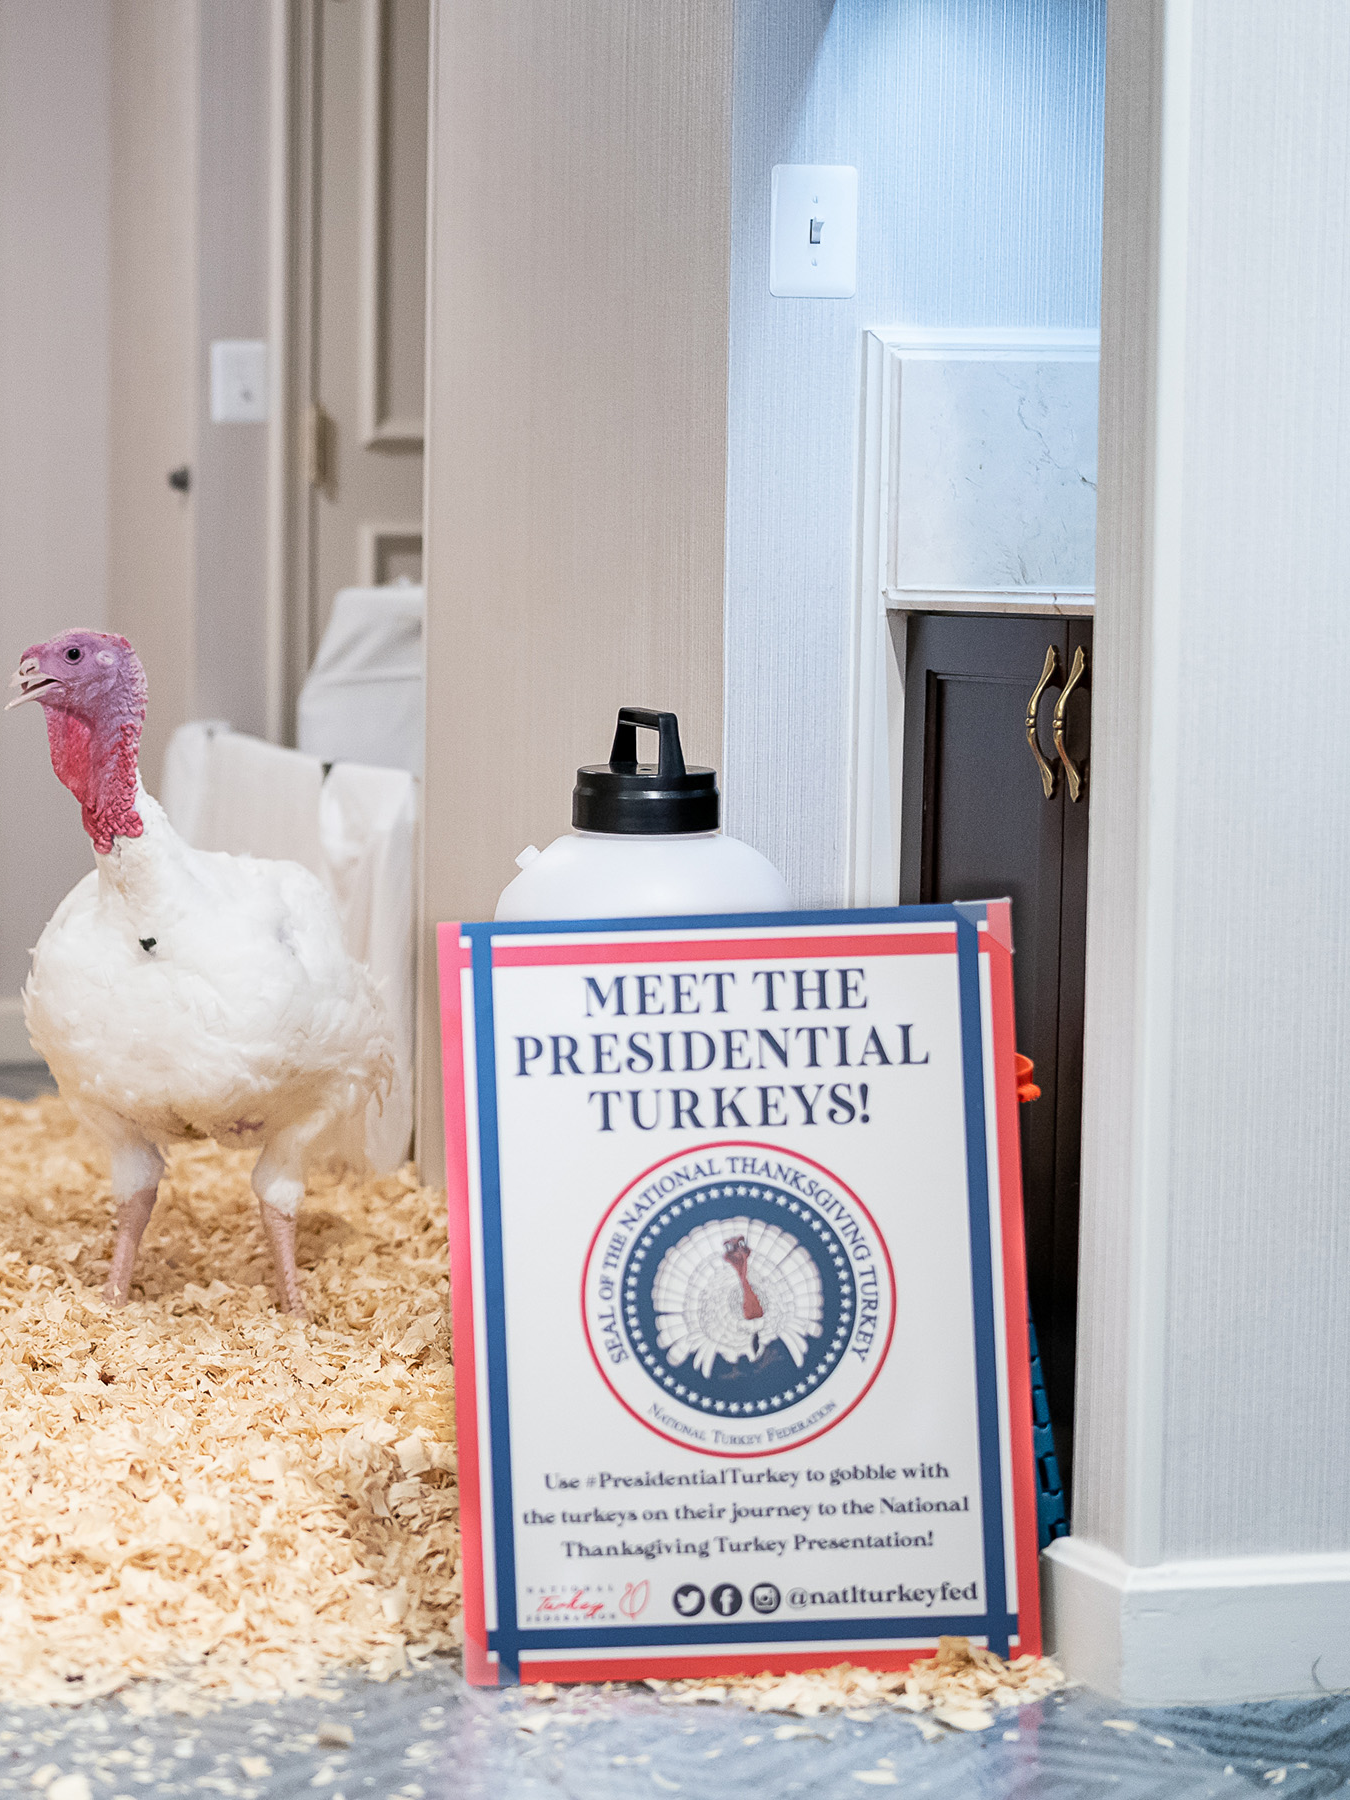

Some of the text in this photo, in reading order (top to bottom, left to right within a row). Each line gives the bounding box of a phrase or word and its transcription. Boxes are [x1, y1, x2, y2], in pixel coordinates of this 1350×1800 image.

[581, 968, 868, 1017] MEET THE
[512, 1023, 930, 1077] PRESIDENTIAL
[588, 1083, 871, 1132] TURKEYS!
[598, 1156, 879, 1364] SEAL OF THE NATIONAL THANKSGIVING TURKEY
[544, 1462, 949, 1489] Use #PresidentialTurkey to gobble with
[523, 1496, 969, 1527] the turkeys on their journey to the National
[561, 1530, 933, 1559] Thanksgiving Turkey Presentation!
[785, 1581, 978, 1609] @natlturkeyfed
